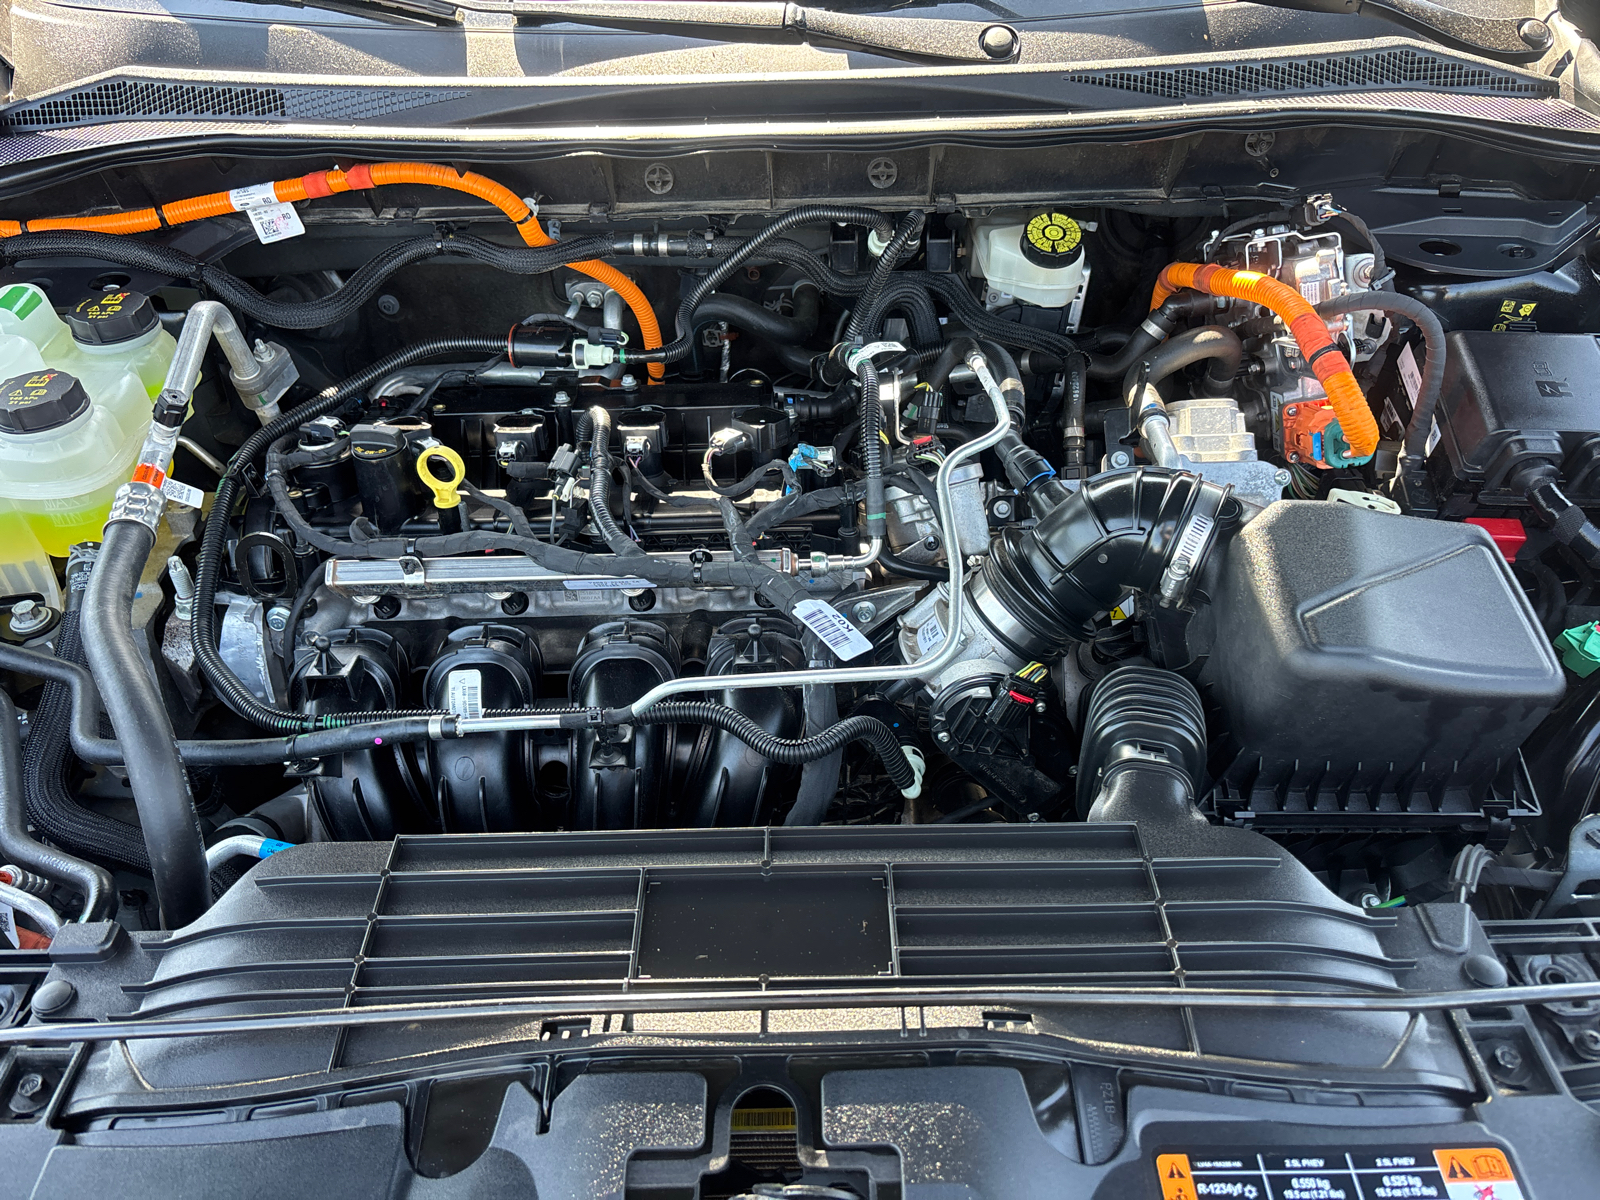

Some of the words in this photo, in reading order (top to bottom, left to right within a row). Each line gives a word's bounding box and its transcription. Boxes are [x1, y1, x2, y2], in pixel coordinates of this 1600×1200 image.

[43, 498, 80, 509] MAX
[50, 512, 84, 525] MIN
[1301, 1158, 1325, 1167] PHEV
[1393, 1157, 1416, 1166] PHEV
[1291, 1177, 1316, 1189] 0.550
[1316, 1177, 1331, 1190] kg
[1408, 1174, 1423, 1188] kg
[1197, 1183, 1243, 1197] R-1234yf
